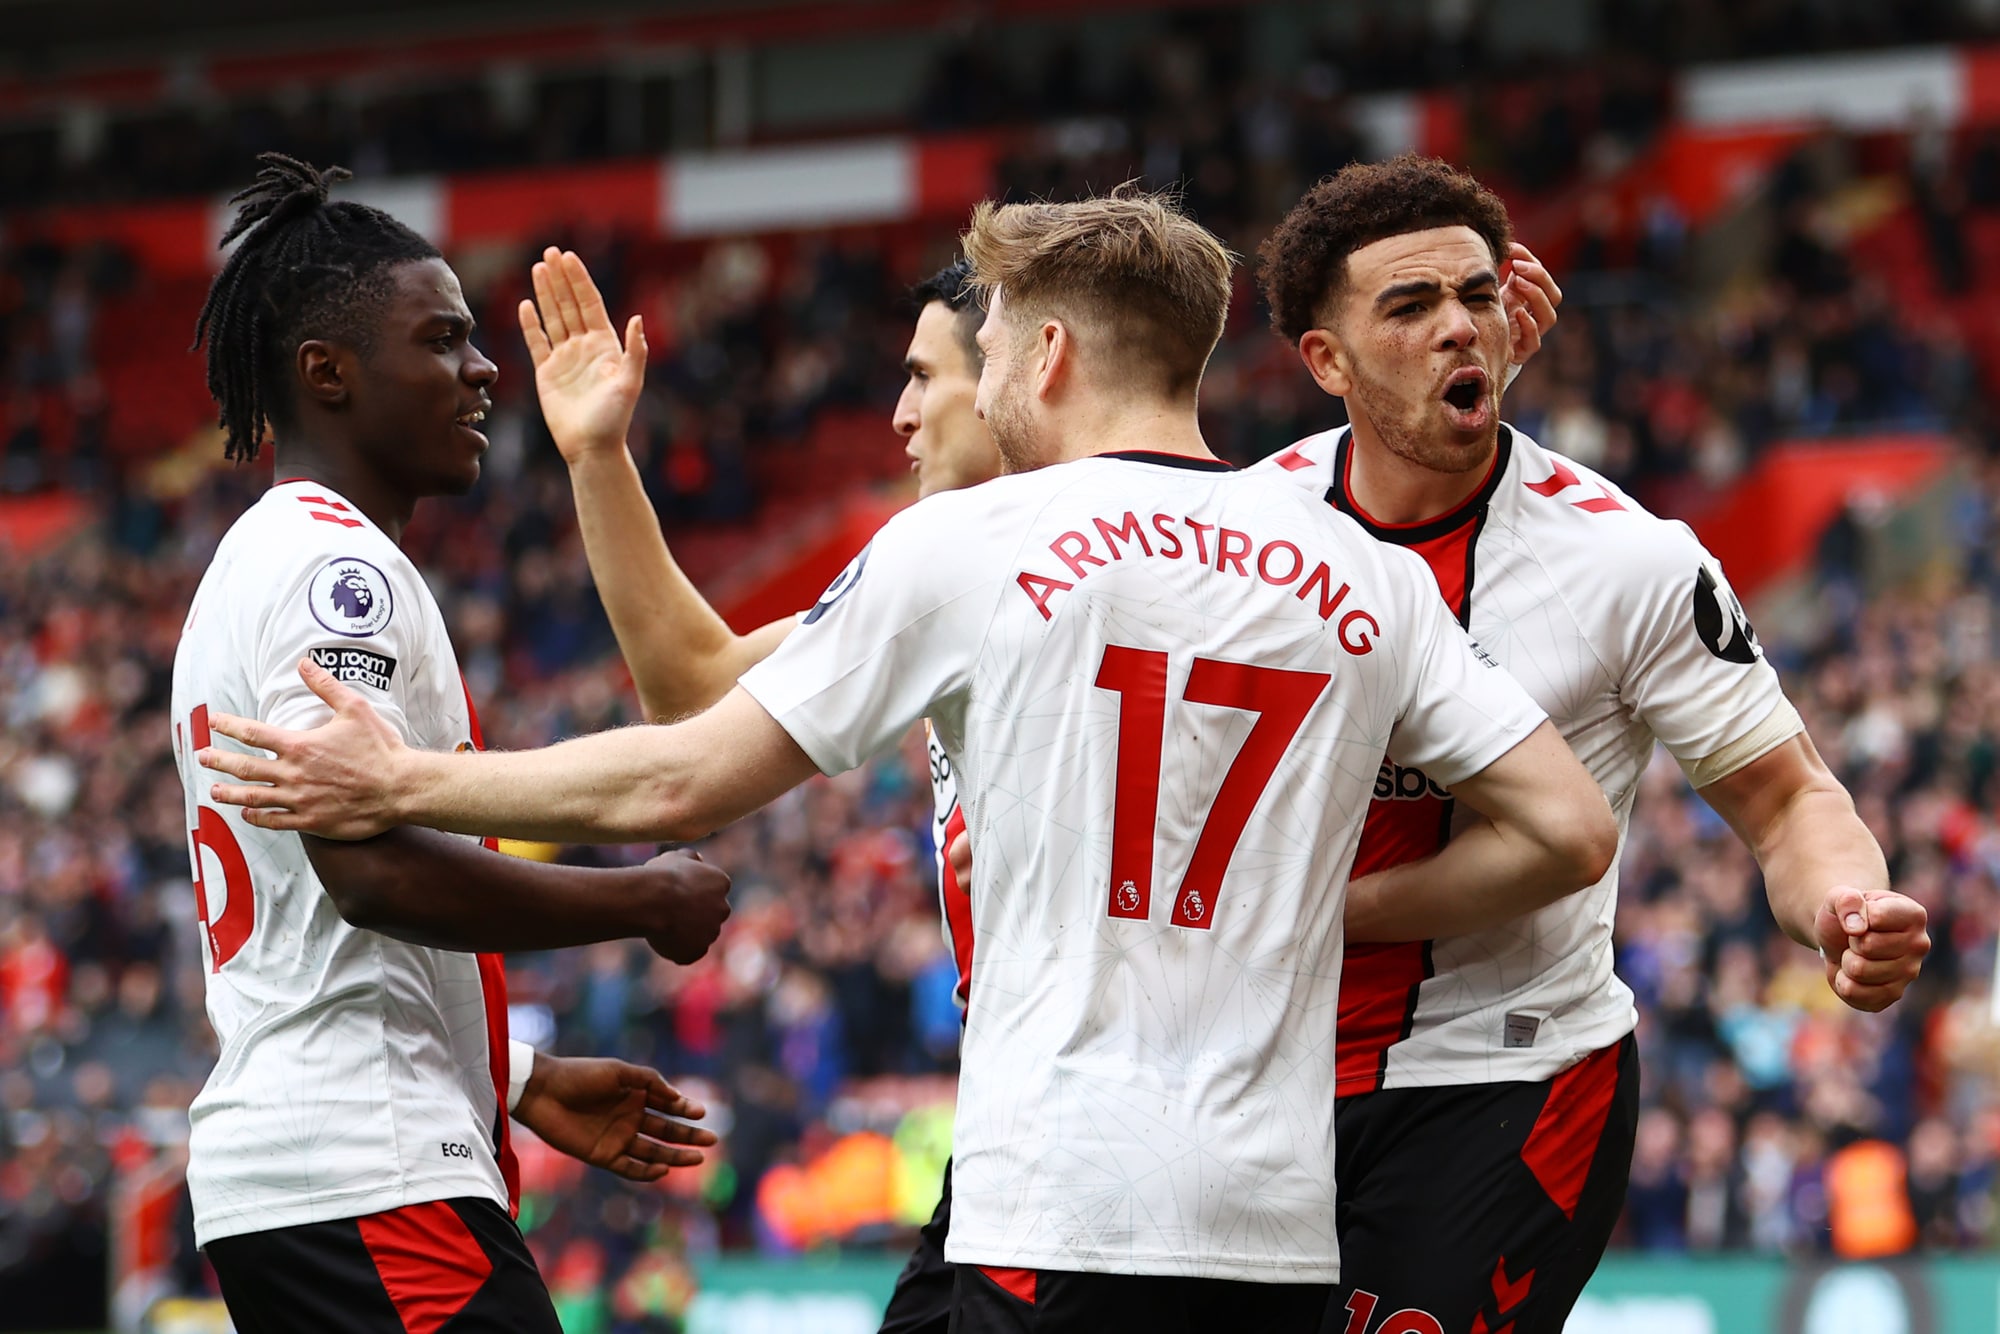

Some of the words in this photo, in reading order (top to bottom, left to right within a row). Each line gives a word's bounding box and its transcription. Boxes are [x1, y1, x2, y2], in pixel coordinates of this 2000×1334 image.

[1016, 511, 1380, 656] ARMSTRONG
[350, 621, 374, 630] Premier
[371, 598, 386, 623] League
[310, 649, 338, 666] No
[341, 651, 387, 674] room
[340, 667, 390, 690] racism
[1094, 643, 1333, 931] 17
